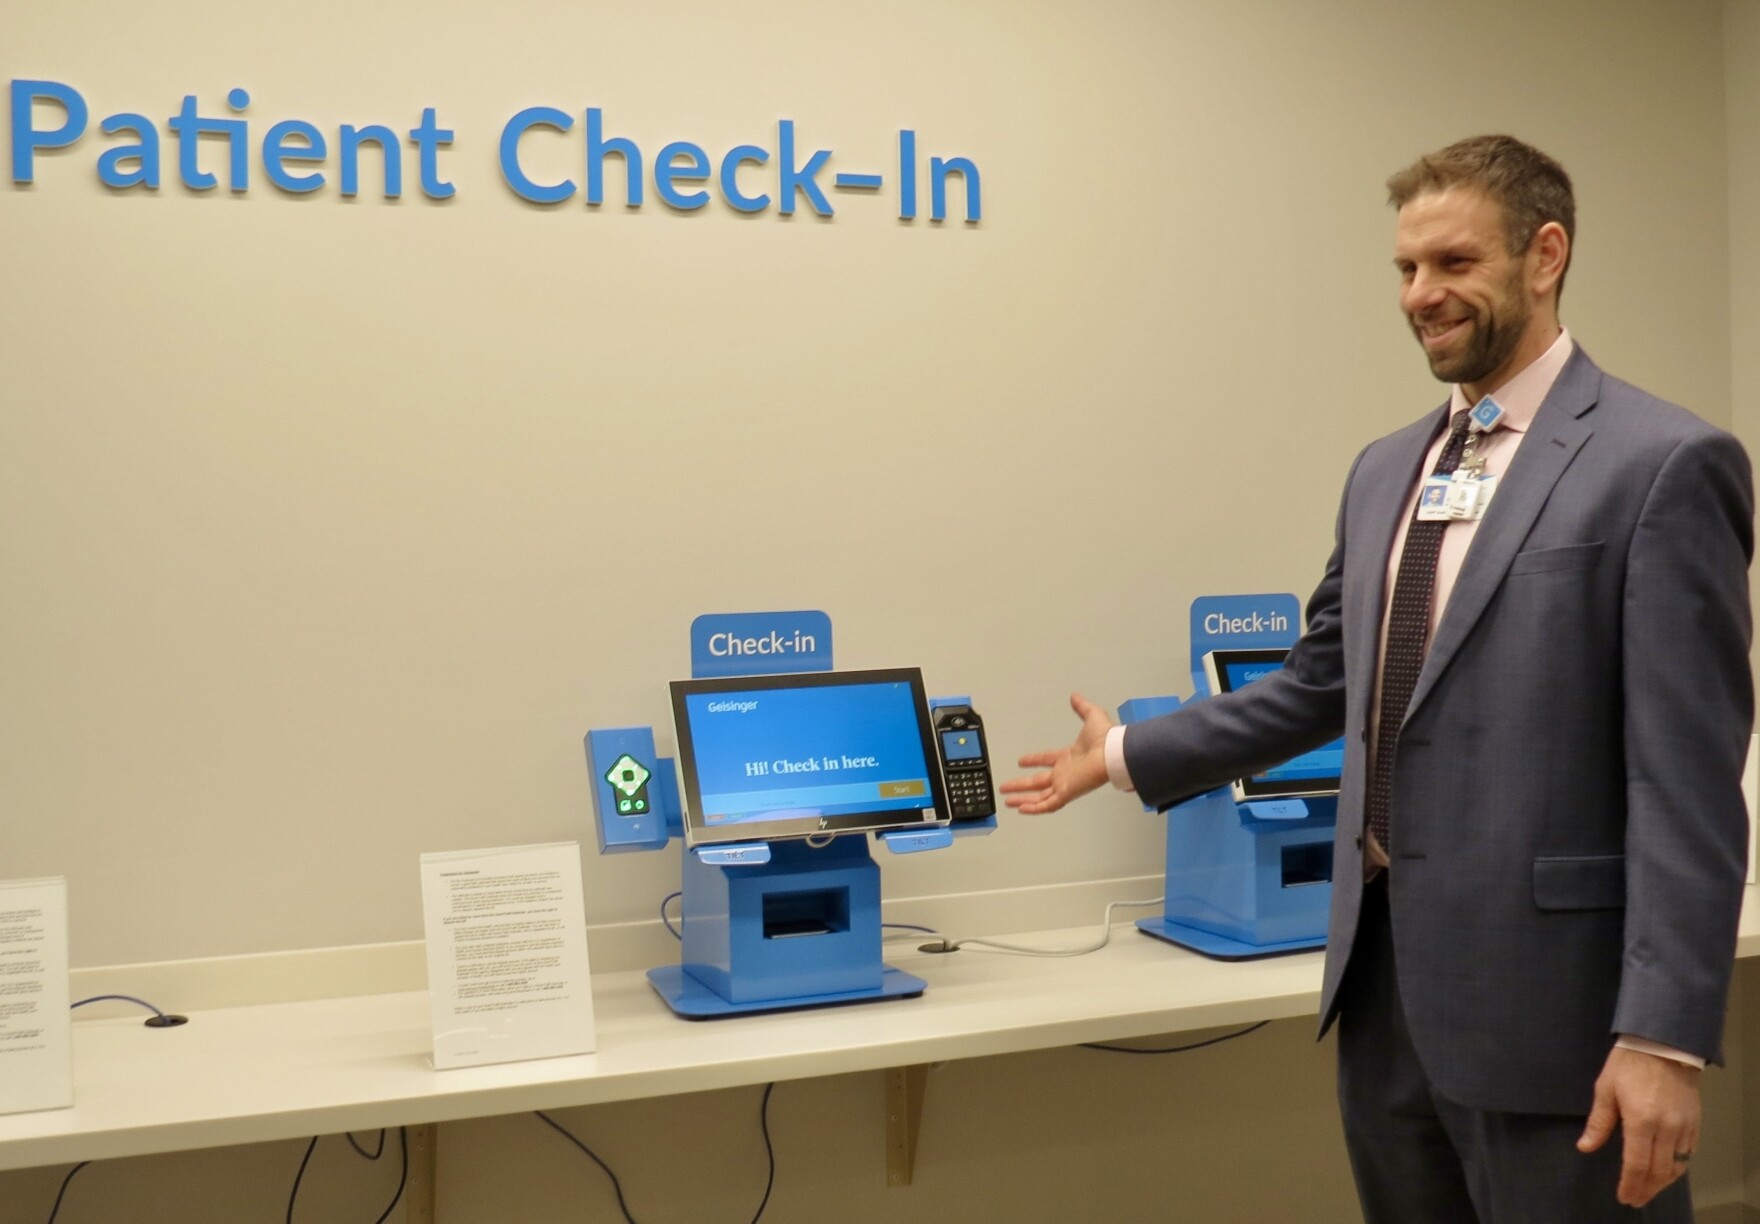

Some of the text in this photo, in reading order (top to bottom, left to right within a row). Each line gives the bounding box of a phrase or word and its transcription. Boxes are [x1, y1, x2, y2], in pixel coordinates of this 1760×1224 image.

[11, 79, 983, 222] Patient Check-In
[1480, 404, 1494, 419] G
[1204, 611, 1288, 634] Check-in
[709, 630, 816, 656] Check-in
[708, 700, 758, 714] Geisinger
[745, 755, 880, 777] Hi! Check in here.
